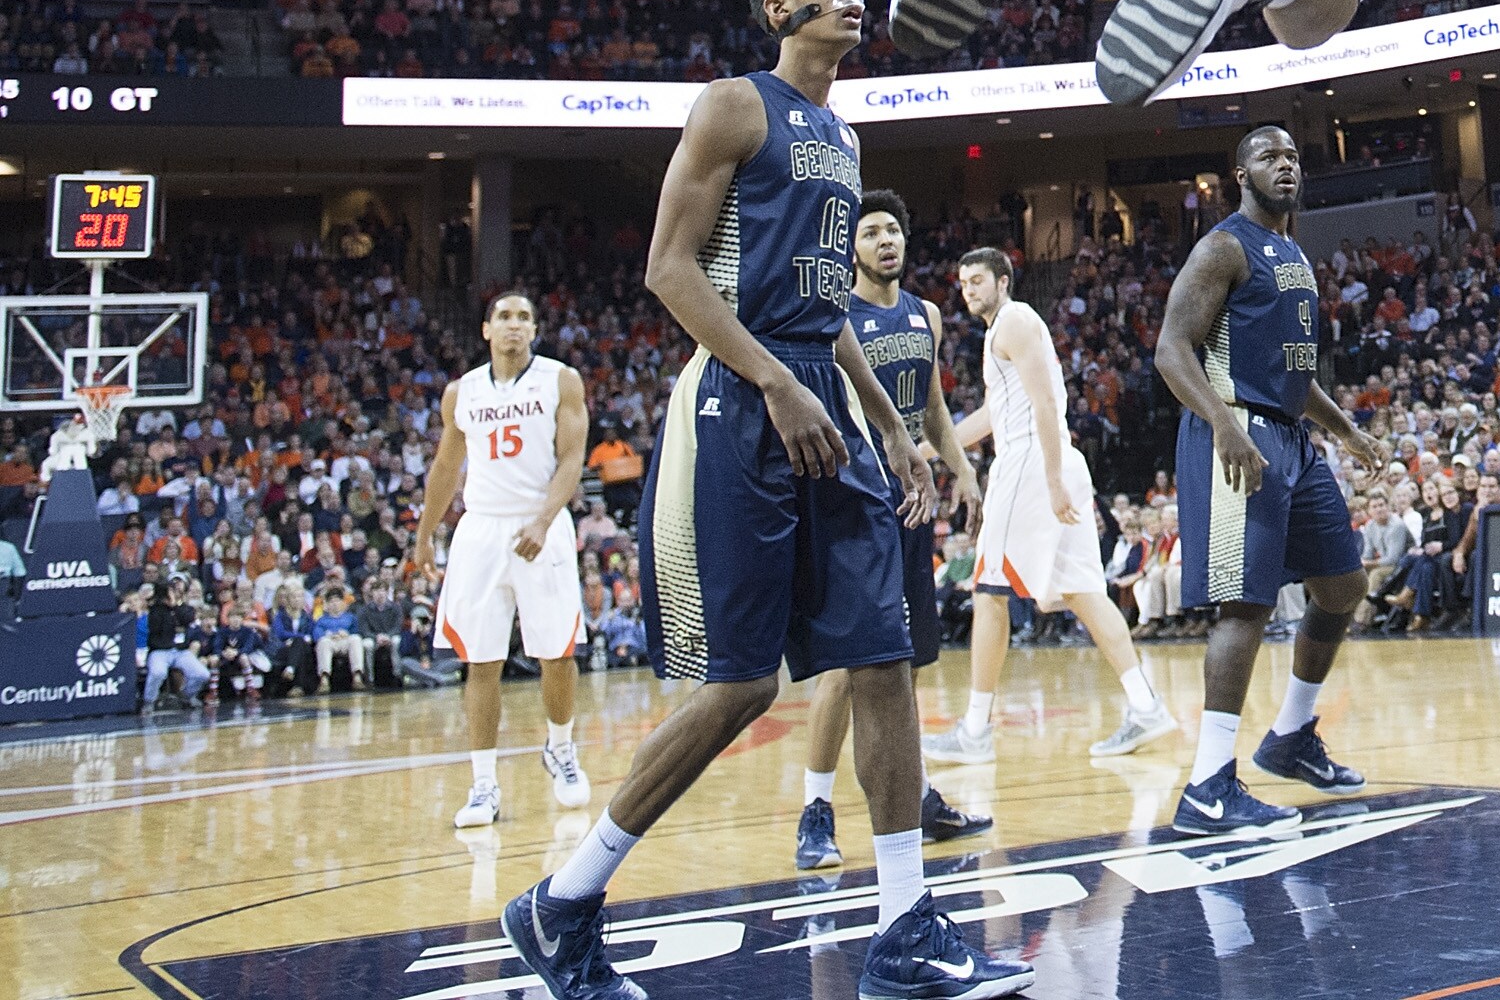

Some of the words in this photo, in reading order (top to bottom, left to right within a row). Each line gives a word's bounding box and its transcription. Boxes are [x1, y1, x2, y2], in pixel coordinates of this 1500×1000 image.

[1423, 18, 1500, 47] CapTech
[1267, 41, 1400, 73] captechconsulting.com
[970, 84, 1016, 98] Others
[1019, 81, 1049, 95] Talk,
[1054, 79, 1075, 91] We
[1079, 78, 1098, 90] Lis
[1180, 63, 1238, 86] pTech
[52, 86, 94, 111] 10
[110, 87, 159, 112] GT
[355, 95, 408, 108] Others
[452, 96, 474, 108] We
[561, 94, 651, 114] CapTech
[864, 85, 949, 108] CapTech
[84, 184, 143, 208] 7:45
[74, 212, 129, 248] 20
[819, 196, 850, 255] 12
[793, 256, 853, 312] TECH
[1298, 299, 1311, 336] 4
[861, 331, 933, 370] GEORGIA
[1282, 342, 1318, 371] TEC
[897, 368, 916, 410] 11
[469, 400, 545, 423] VIRGINIA
[488, 424, 523, 460] 15
[26, 574, 111, 591] ORTHOPEDICS
[47, 560, 92, 578] UVA
[0, 677, 119, 705] CenturyLink
